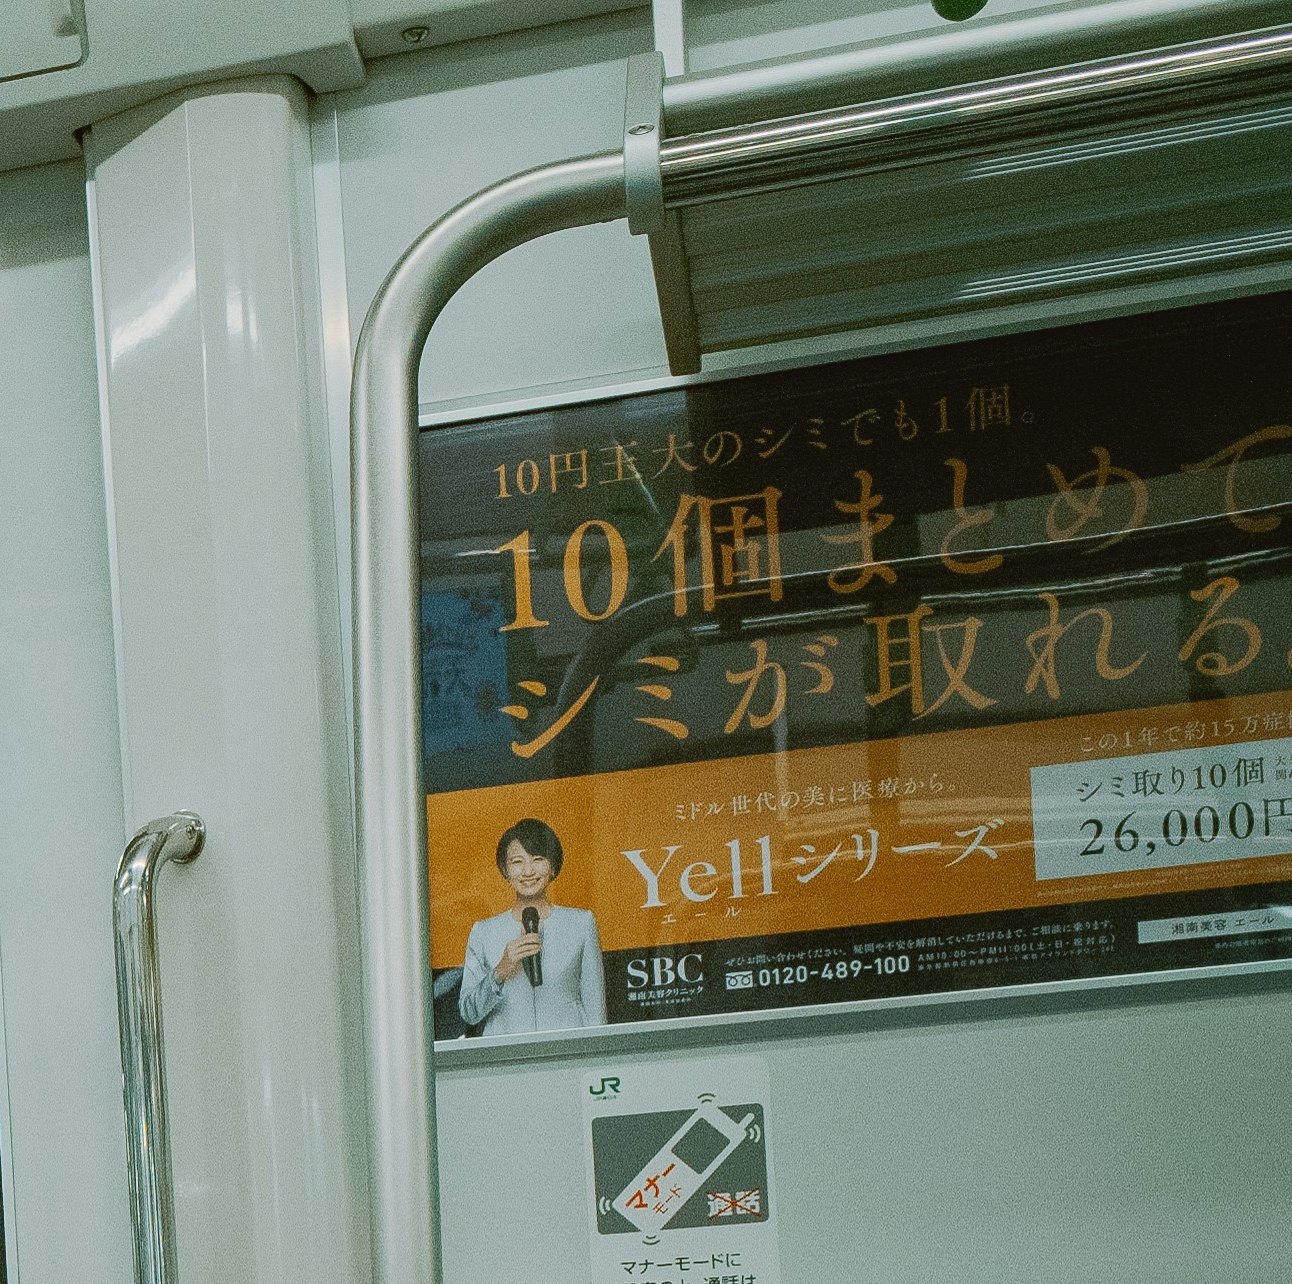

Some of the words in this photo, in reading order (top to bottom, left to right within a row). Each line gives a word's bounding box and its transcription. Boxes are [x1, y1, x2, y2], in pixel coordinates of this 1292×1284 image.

[494, 424, 1292, 632] 10個まとめて
[1075, 757, 1266, 803] シミ取り10個
[620, 817, 1006, 909] Yellシリーズ
[626, 953, 704, 989] SBC
[758, 955, 910, 987] 0120-489-100
[589, 1076, 621, 1096] JR
[625, 1163, 676, 1211] マナー
[620, 1252, 742, 1275] マナーモードに
